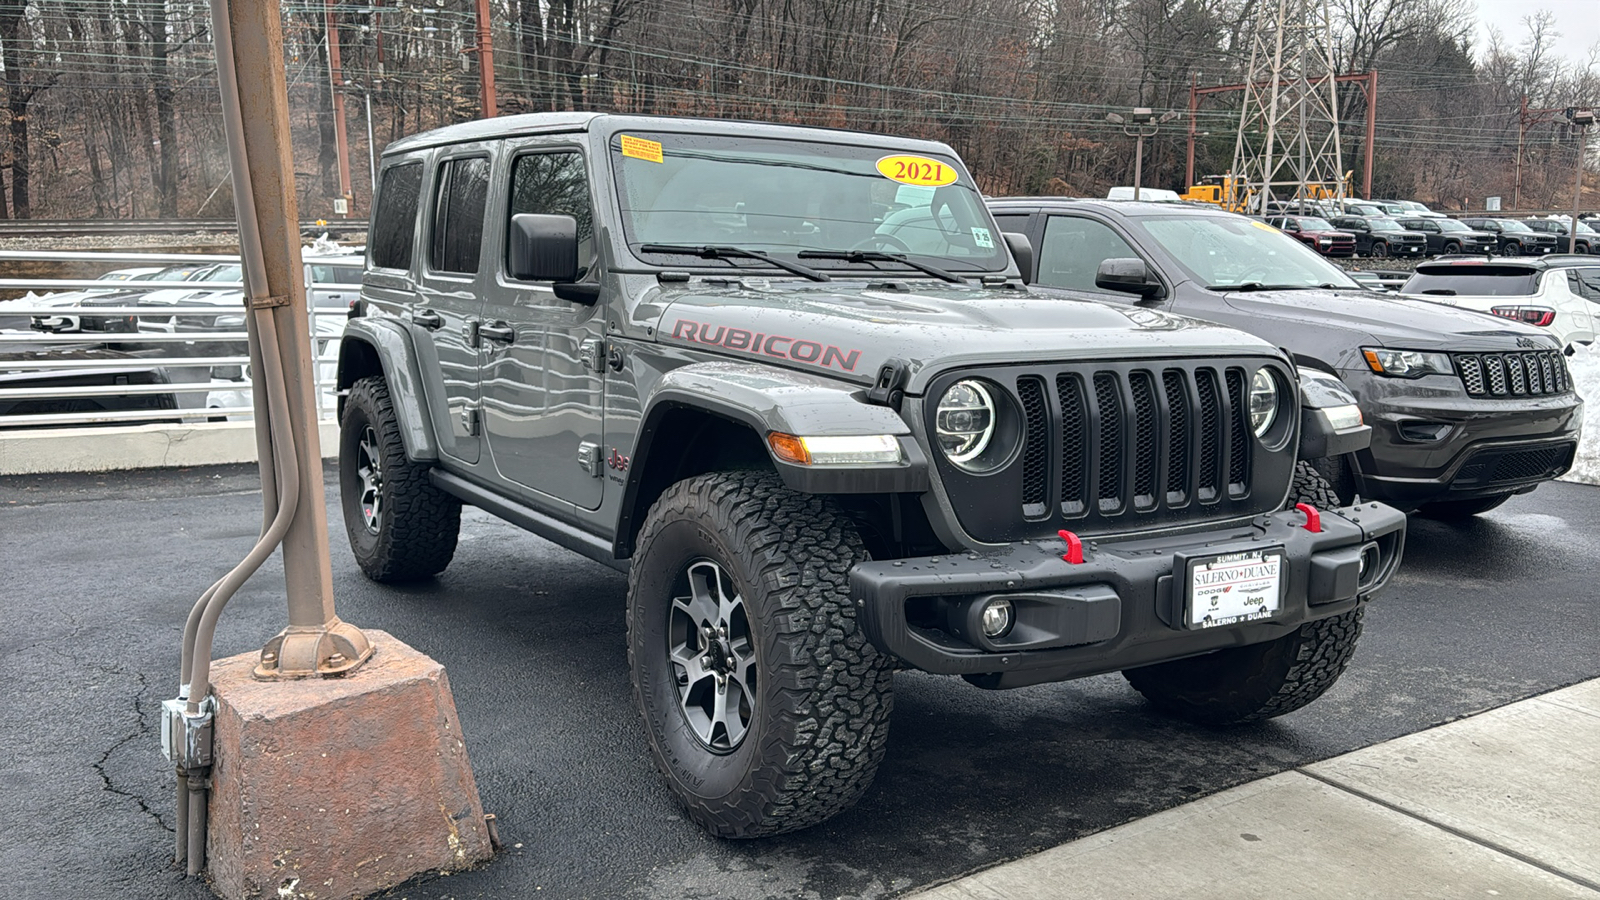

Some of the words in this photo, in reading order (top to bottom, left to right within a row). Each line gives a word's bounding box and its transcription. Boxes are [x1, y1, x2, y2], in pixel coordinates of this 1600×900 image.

[895, 161, 942, 181] 2021
[672, 319, 862, 372] RUBICON
[1252, 551, 1263, 559] NJ
[1194, 569, 1239, 585] SALERNO
[1243, 564, 1277, 579] DUANE
[1243, 595, 1264, 607] Jeep
[1202, 616, 1238, 629] SALERNO
[1247, 611, 1272, 621] DUANE
